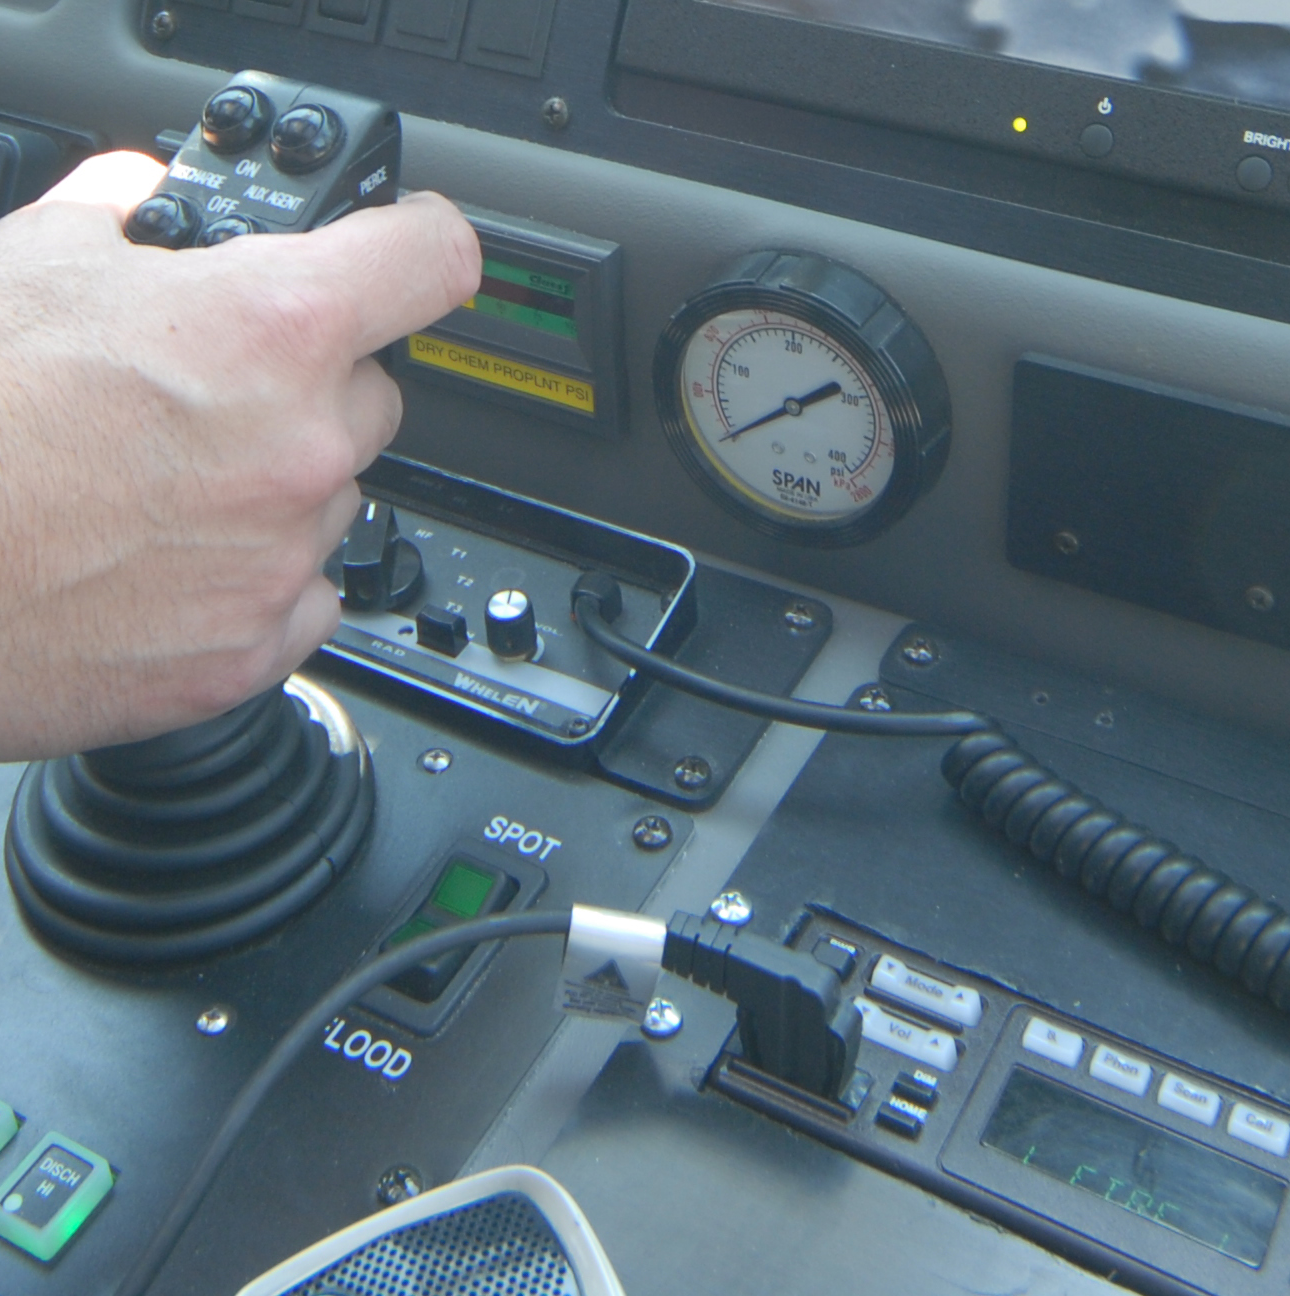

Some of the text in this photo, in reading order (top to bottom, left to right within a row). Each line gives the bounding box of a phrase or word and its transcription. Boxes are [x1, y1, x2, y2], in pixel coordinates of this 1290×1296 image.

[168, 161, 227, 190] DISCHARGE
[235, 158, 262, 179] ON
[359, 165, 389, 196] PIERCE
[207, 194, 241, 215] OFF
[243, 184, 305, 212] AUX AGENT
[784, 340, 803, 355] 200
[415, 339, 590, 402] DRY CHEM PROPLNT PSI
[731, 363, 751, 378] 100
[840, 392, 860, 407] 300
[827, 450, 847, 464] 400
[772, 468, 821, 497] SPAN
[830, 467, 845, 478] psi
[415, 528, 434, 540] HF
[451, 547, 469, 560] T1
[456, 574, 474, 588] T2
[445, 601, 463, 614] T3
[371, 639, 406, 657] RAD
[453, 671, 541, 716] WHELEN
[483, 814, 562, 862] SPOT
[904, 973, 944, 999] Mode
[888, 1022, 913, 1041] Vol
[323, 1016, 413, 1081] LOOD
[1103, 1052, 1141, 1076] Phon
[914, 1069, 939, 1087] DIM
[1173, 1080, 1208, 1105] Scan
[890, 1097, 929, 1122] HOME
[1245, 1112, 1275, 1134] Call
[38, 1156, 81, 1188] DISCH
[35, 1178, 53, 1198] HI
